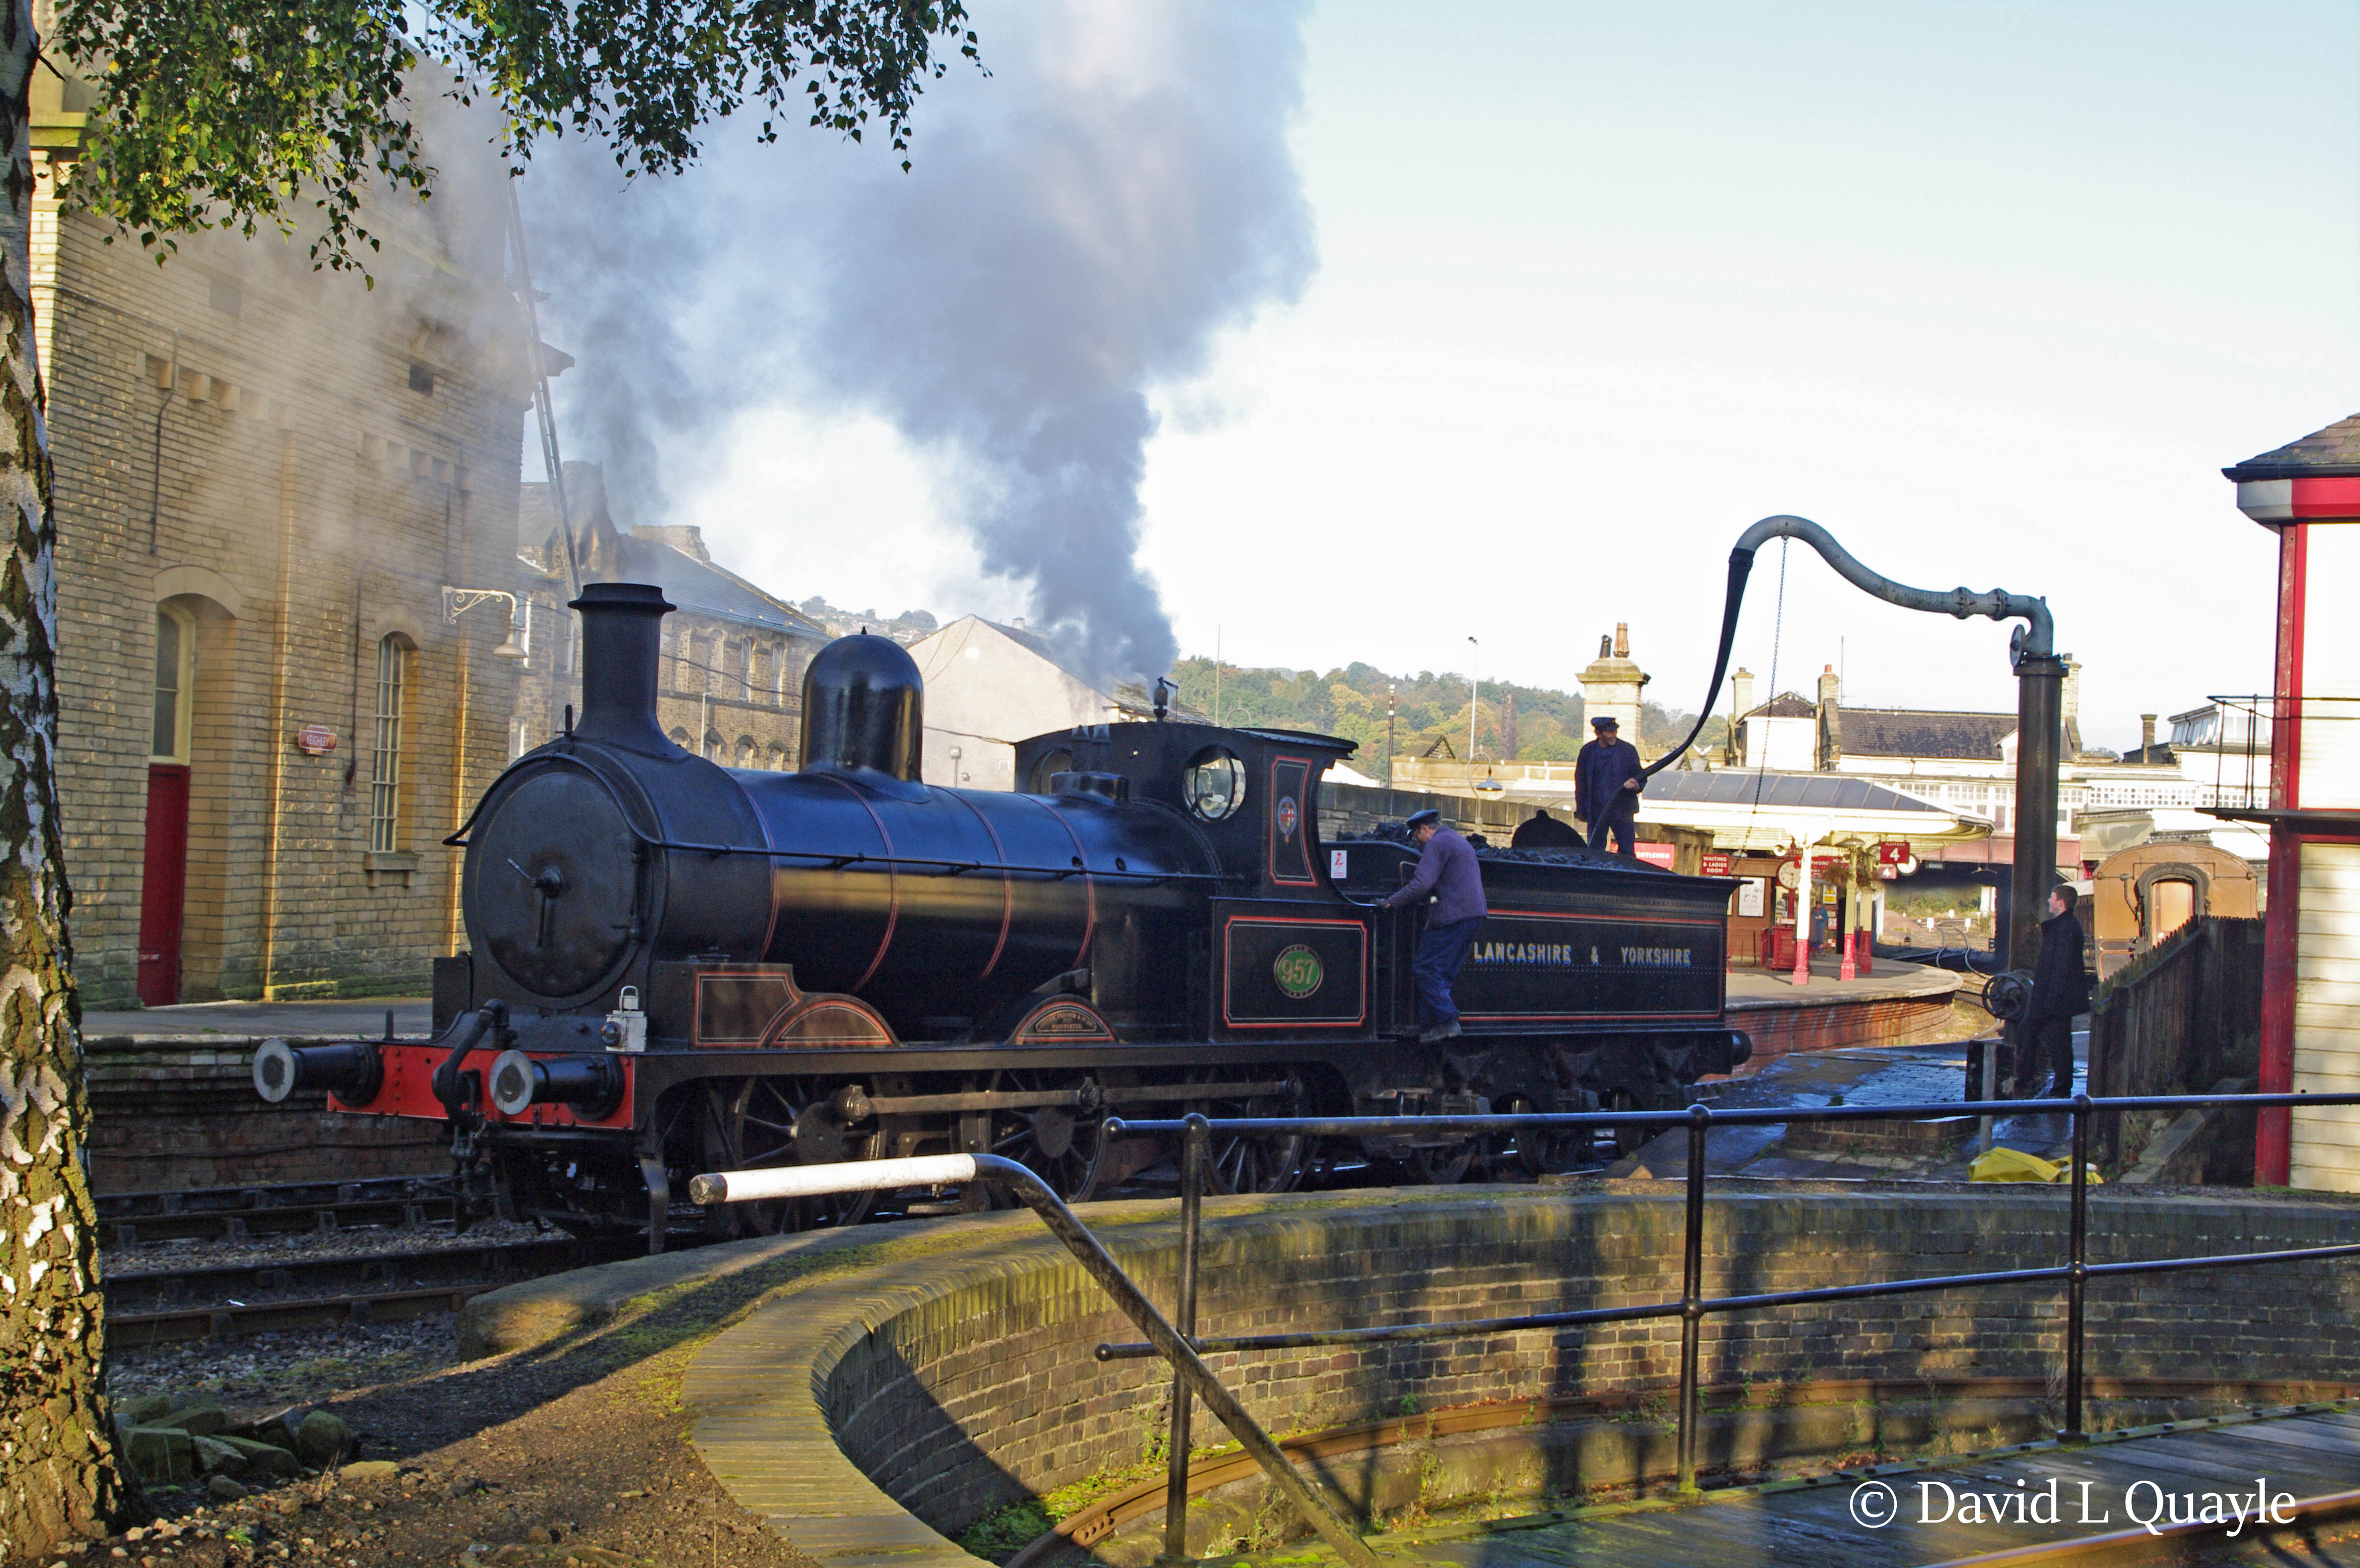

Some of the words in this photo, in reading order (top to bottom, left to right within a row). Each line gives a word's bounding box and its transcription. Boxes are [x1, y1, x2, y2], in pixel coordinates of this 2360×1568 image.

[306, 735, 329, 747] KEIGHLEY
[1890, 848, 1900, 861] 4
[1883, 868, 1890, 877] 4
[1474, 942, 1571, 965] LANCASHIRE
[1591, 946, 1599, 965] &
[1620, 947, 1691, 967] YORKSHIRE
[1282, 959, 1314, 985] 957
